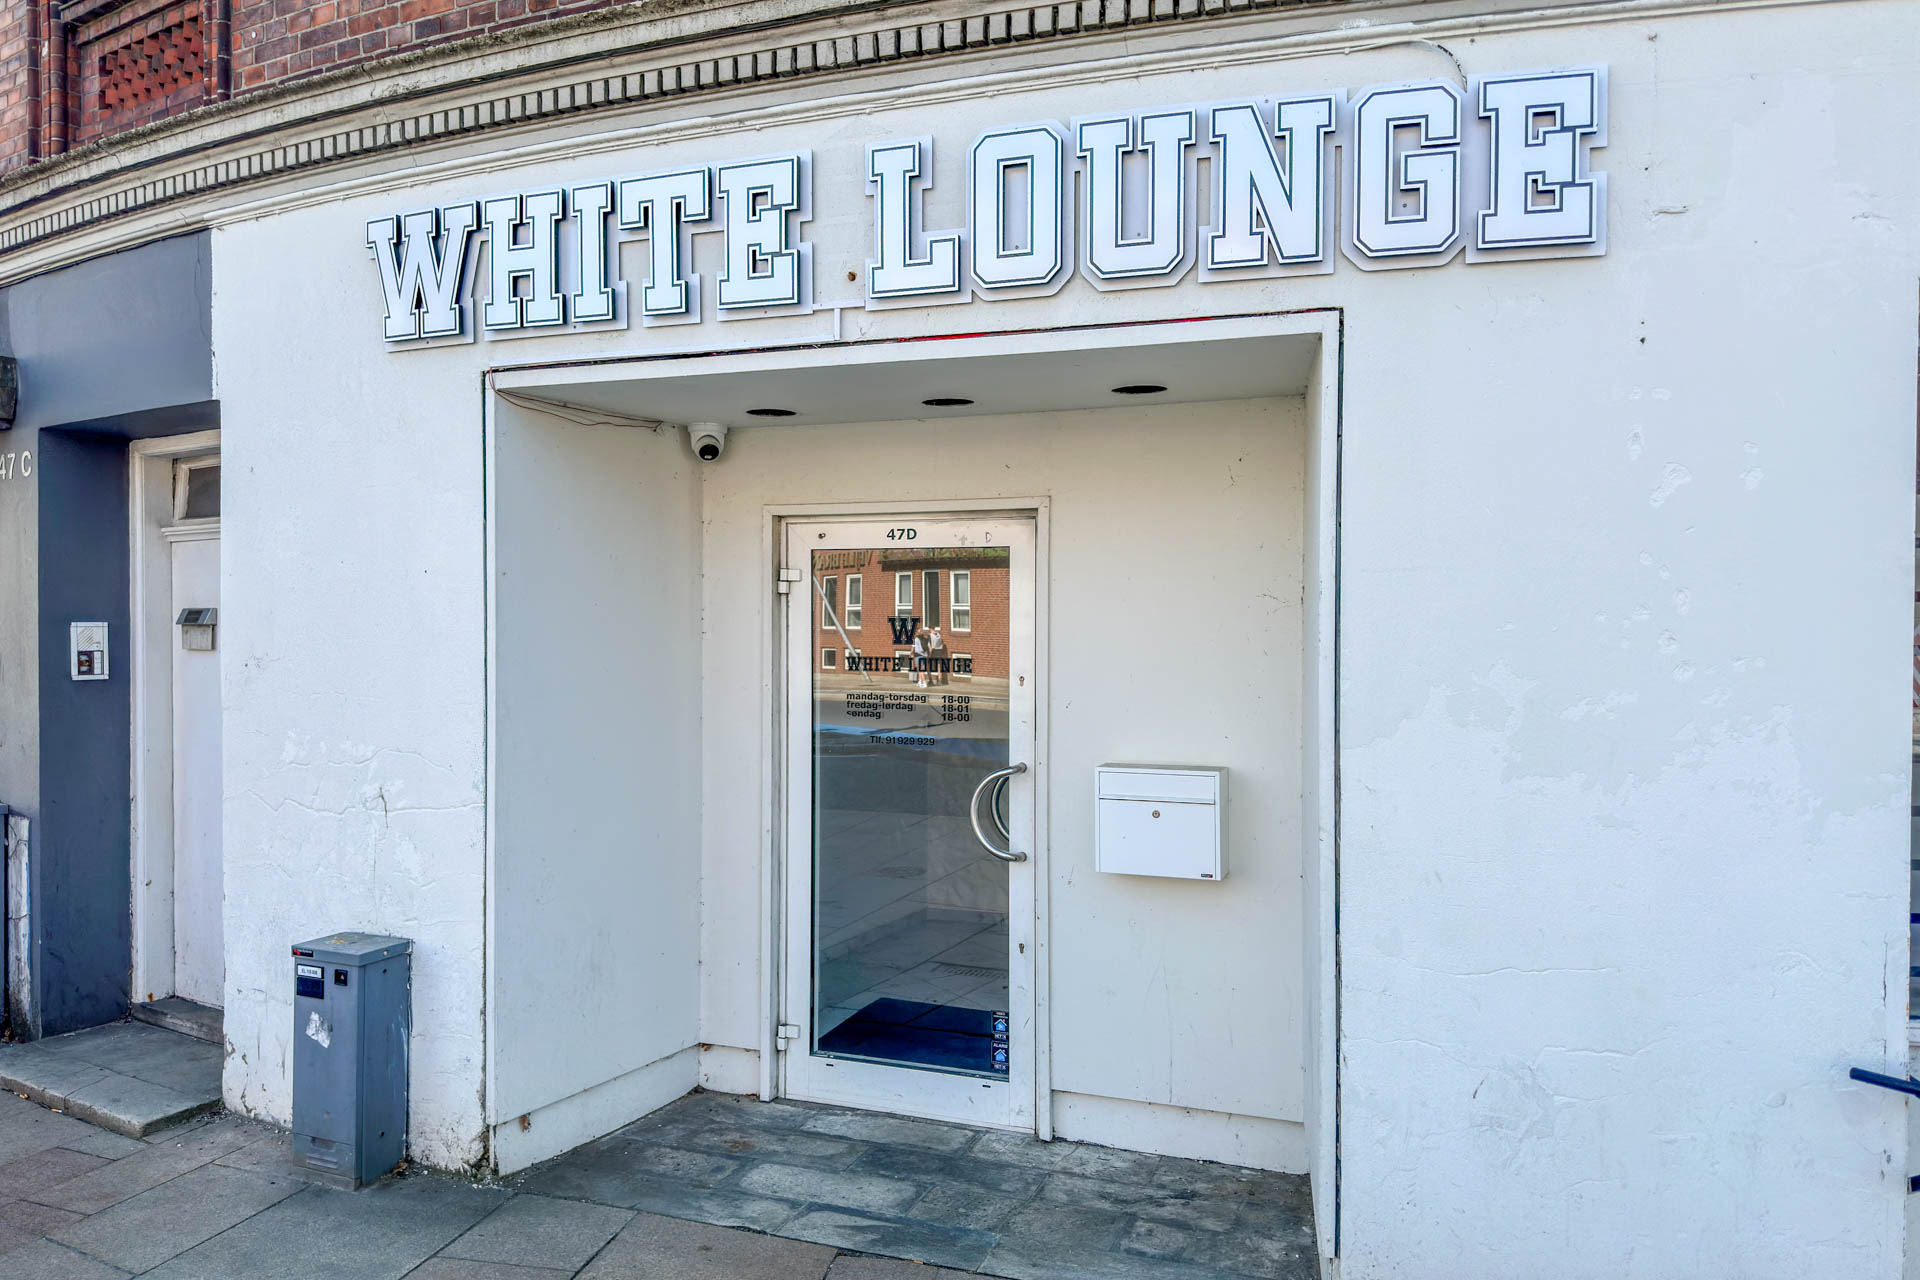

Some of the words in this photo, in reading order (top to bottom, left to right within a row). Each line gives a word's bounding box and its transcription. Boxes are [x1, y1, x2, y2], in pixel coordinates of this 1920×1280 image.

[366, 154, 800, 343] WHITE
[868, 70, 1599, 300] LOUNGE
[0, 452, 16, 480] 47
[21, 450, 32, 477] C
[886, 528, 918, 541] 47D
[888, 616, 920, 645] W
[846, 656, 900, 672] WHITE
[908, 657, 973, 673] LOUNGE
[846, 693, 927, 703] mandag-torsdag
[941, 695, 970, 704] 18-00
[941, 704, 969, 713] 18-01
[941, 713, 970, 722] 18-00
[869, 735, 884, 744] Tlf.
[917, 737, 935, 746] 929
